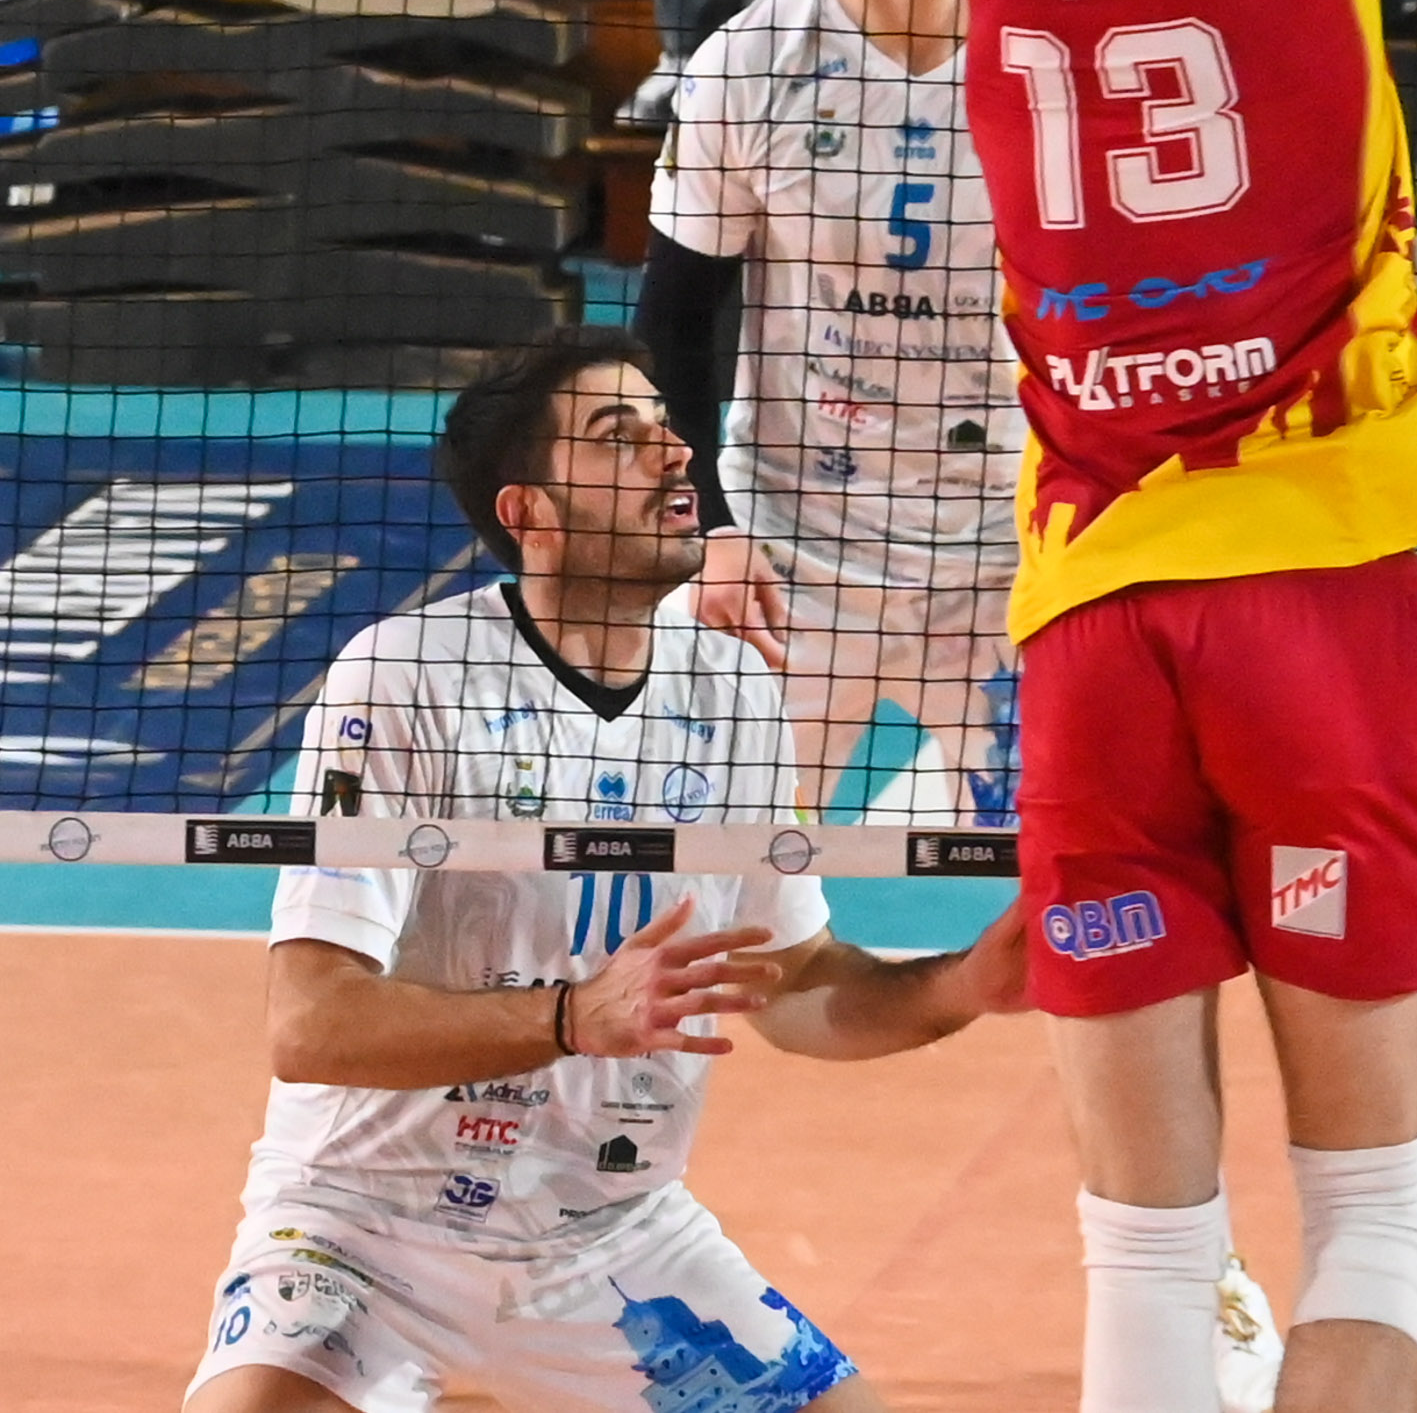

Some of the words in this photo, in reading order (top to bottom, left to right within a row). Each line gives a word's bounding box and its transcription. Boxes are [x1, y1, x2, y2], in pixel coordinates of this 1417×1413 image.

[1000, 16, 1250, 230] 13
[885, 182, 936, 272] 5
[844, 288, 936, 321] ABBA
[1045, 336, 1277, 411] PLATFORM
[1271, 857, 1342, 917] TMC
[1041, 889, 1167, 962] QBM
[457, 1114, 520, 1145] HTC
[212, 1305, 252, 1354] 10
